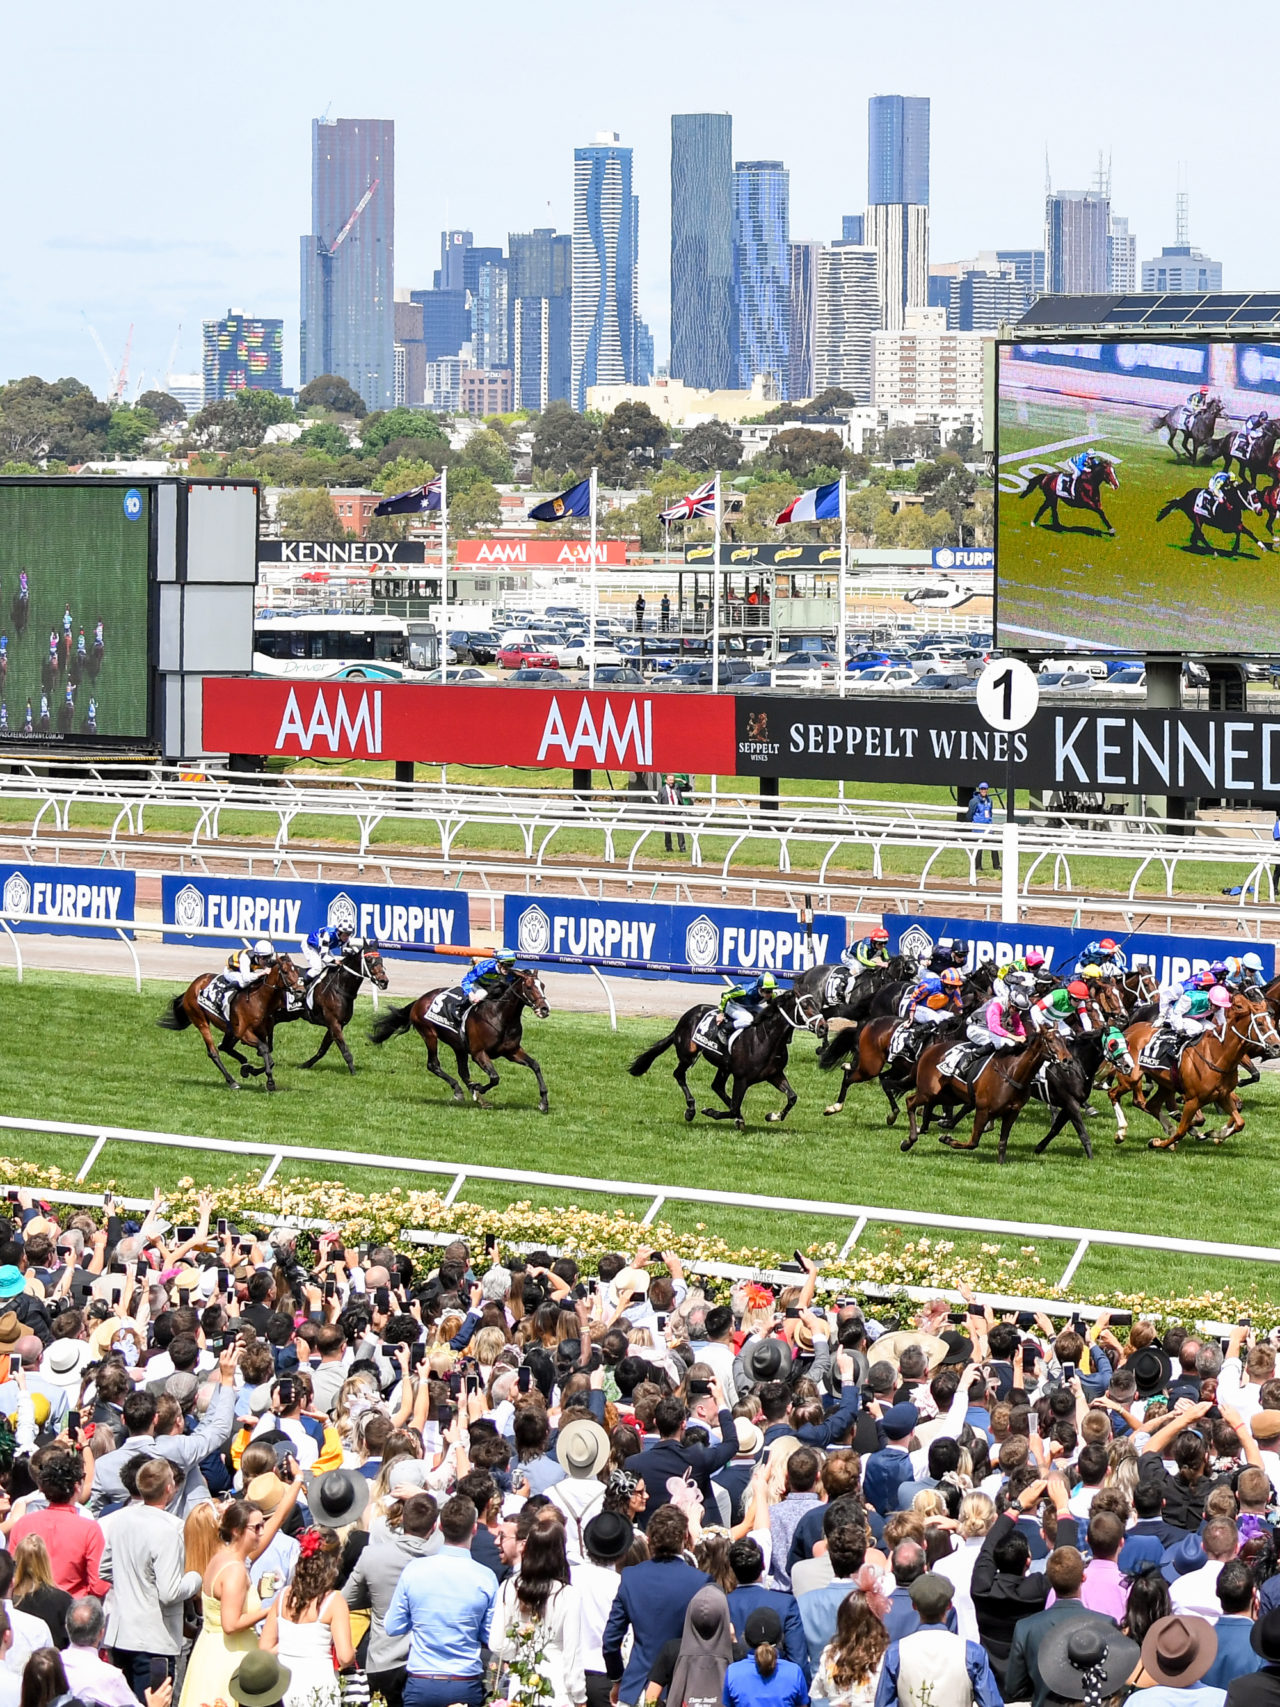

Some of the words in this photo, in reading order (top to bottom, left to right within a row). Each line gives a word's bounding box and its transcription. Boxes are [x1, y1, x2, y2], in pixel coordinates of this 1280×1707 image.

[126, 497, 140, 513] 10
[281, 542, 398, 562] KENNEDY
[476, 543, 527, 562] AAMI
[557, 543, 608, 562] AAMI
[955, 550, 994, 567] FURP
[283, 661, 331, 674] Driver
[993, 669, 1014, 720] 1
[275, 685, 382, 754] AAMI
[537, 695, 653, 766] AAMI
[738, 741, 780, 755] SEPPELT
[790, 723, 919, 758] SEPPELT
[929, 728, 1028, 763] WINES
[750, 754, 769, 762] WINES
[33, 882, 122, 921] FURPHY
[207, 894, 302, 935] FURPHY
[360, 903, 455, 945] FURPHY
[553, 916, 657, 960] FURPHY
[722, 927, 830, 971] FURPHY
[430, 993, 448, 1013] 5
[698, 1015, 715, 1036] 4
[752, 1271, 775, 1283] water
